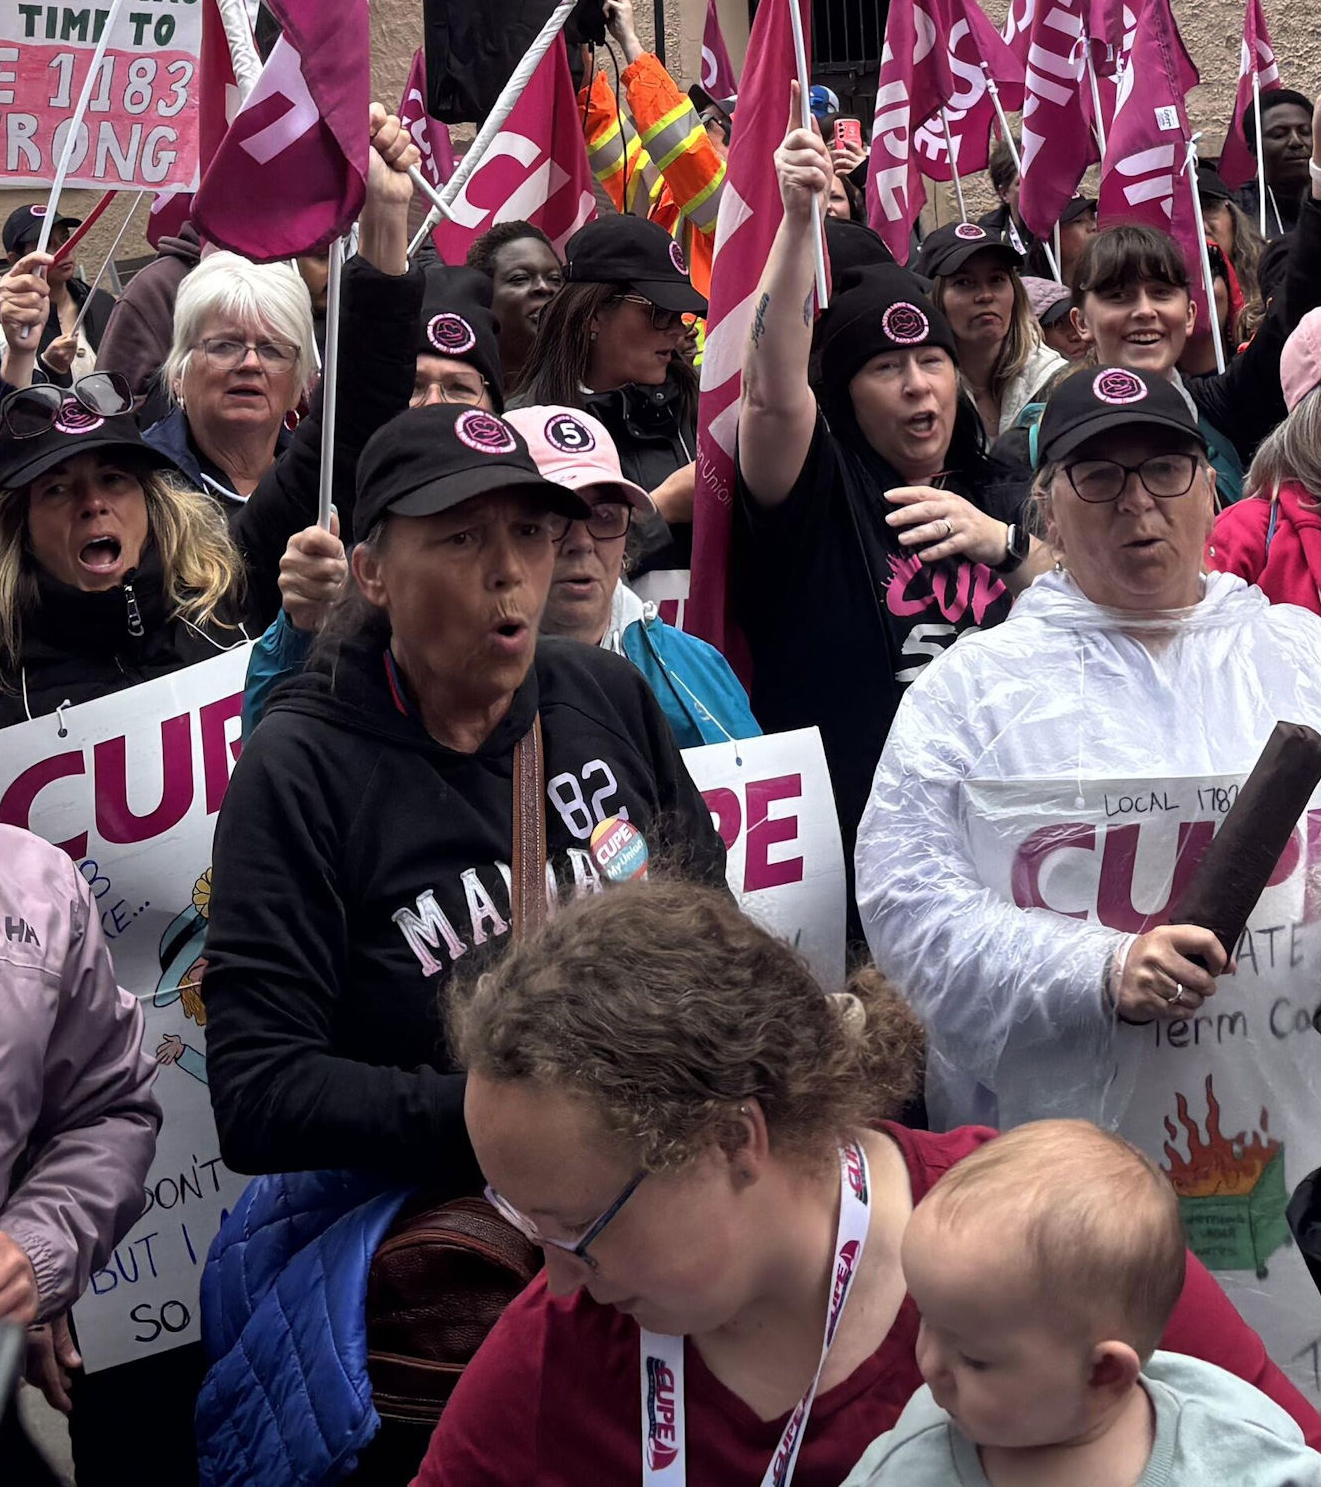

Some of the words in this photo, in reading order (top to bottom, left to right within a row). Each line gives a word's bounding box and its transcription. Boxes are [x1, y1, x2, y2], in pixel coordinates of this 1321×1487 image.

[129, 12, 175, 46] TO
[48, 52, 194, 118] 1183
[559, 423, 582, 444] 5
[548, 759, 629, 839] 82
[1105, 792, 1180, 817] LOCAL
[596, 823, 633, 866] CUPE
[700, 773, 804, 893] PE
[607, 864, 623, 880] My
[620, 839, 644, 864] Union
[1232, 922, 1305, 976] ATE
[1270, 997, 1312, 1039] Ca
[130, 1299, 191, 1342] SO
[656, 1366, 676, 1442] CUPE
